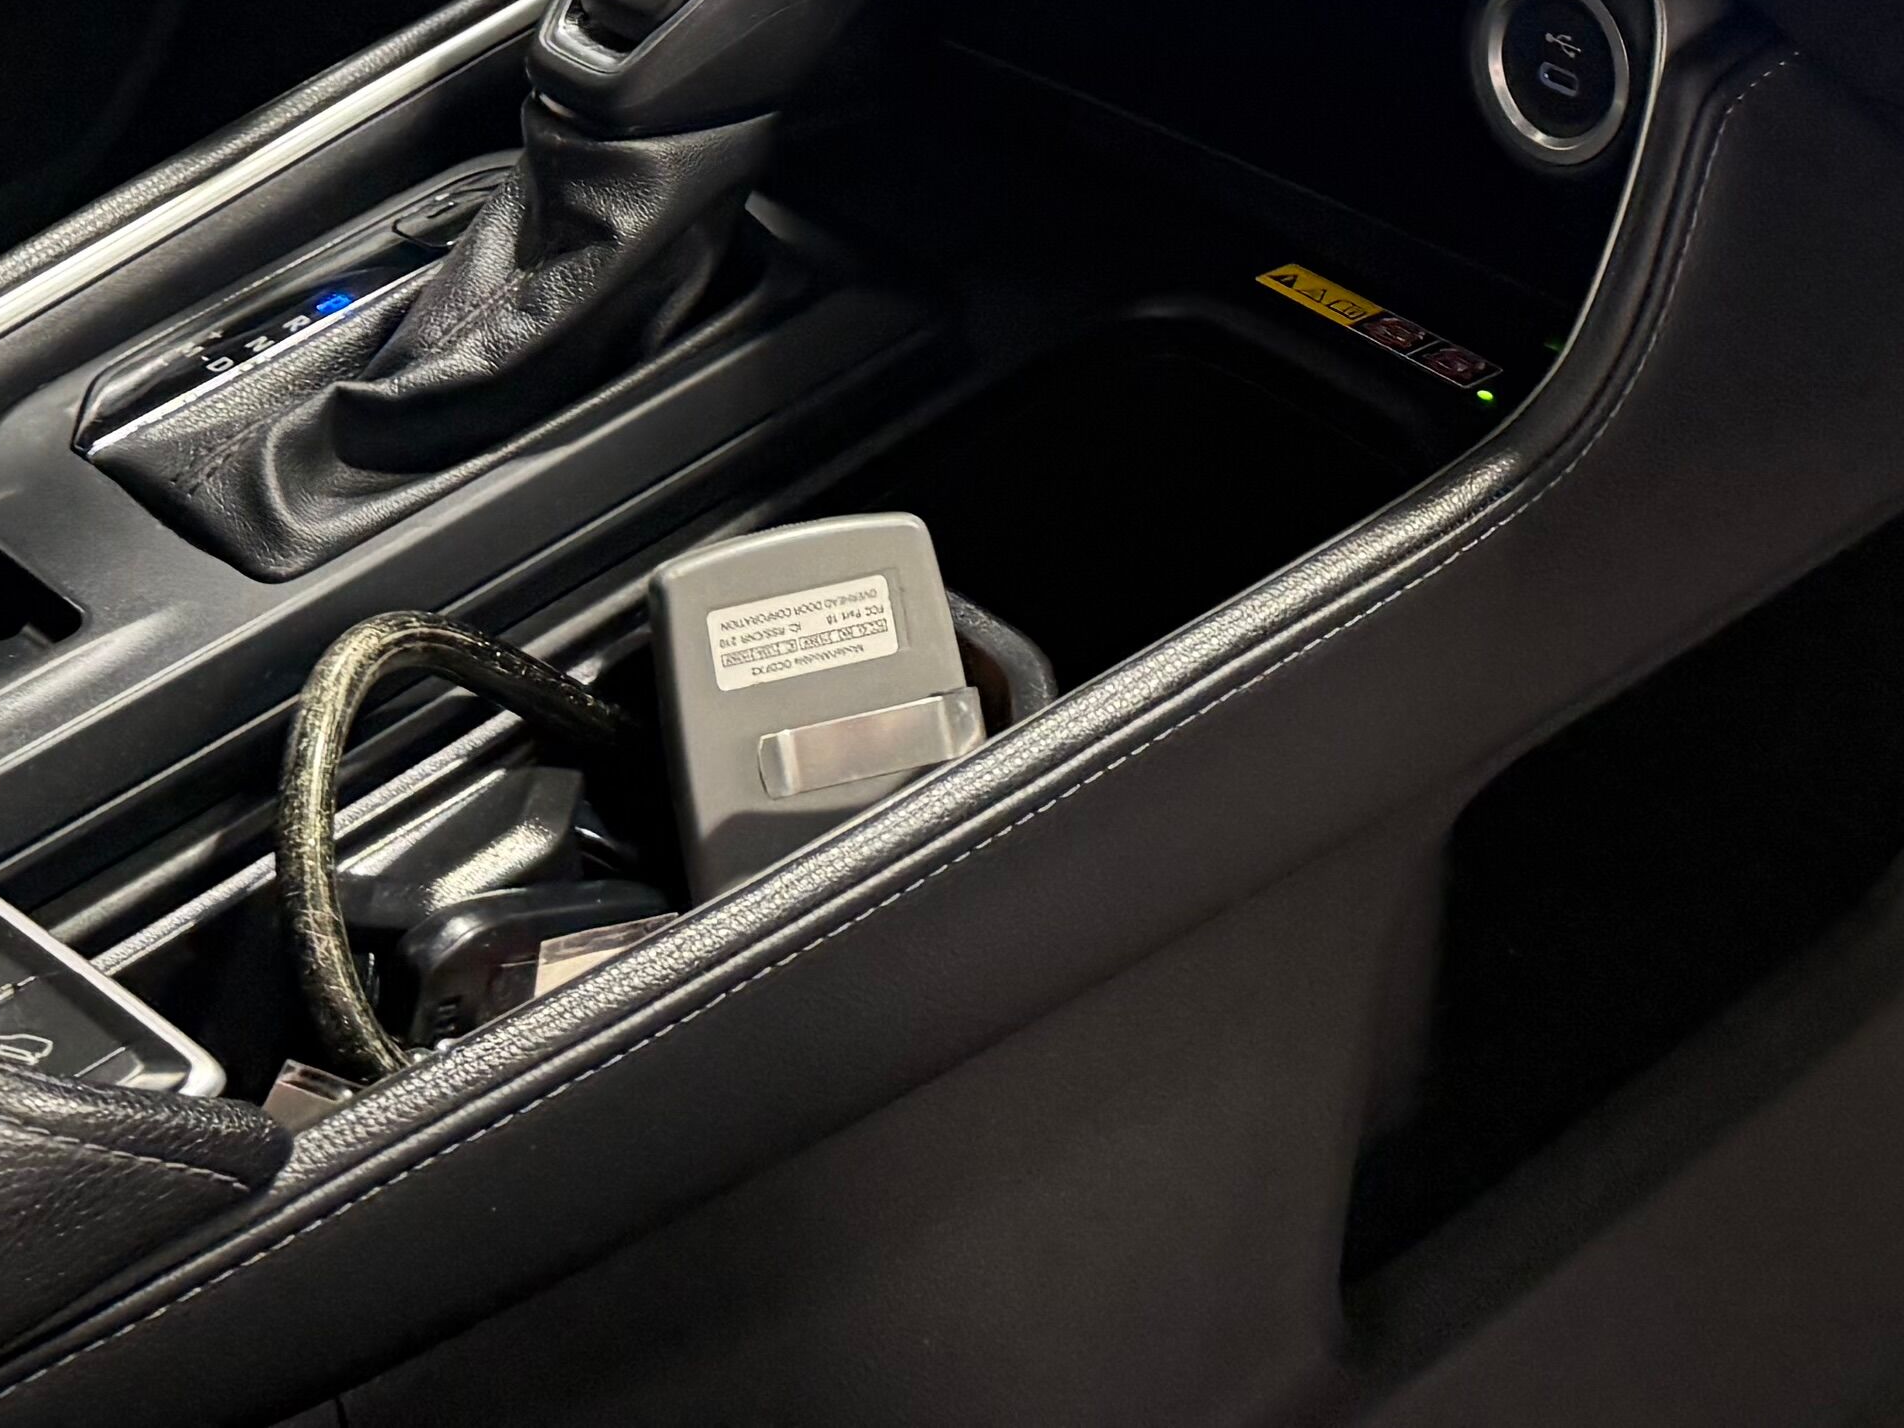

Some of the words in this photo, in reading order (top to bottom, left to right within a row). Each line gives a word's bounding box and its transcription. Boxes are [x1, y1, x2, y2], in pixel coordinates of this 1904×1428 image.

[282, 314, 312, 333] R
[245, 335, 276, 353] N
[206, 356, 235, 373] D
